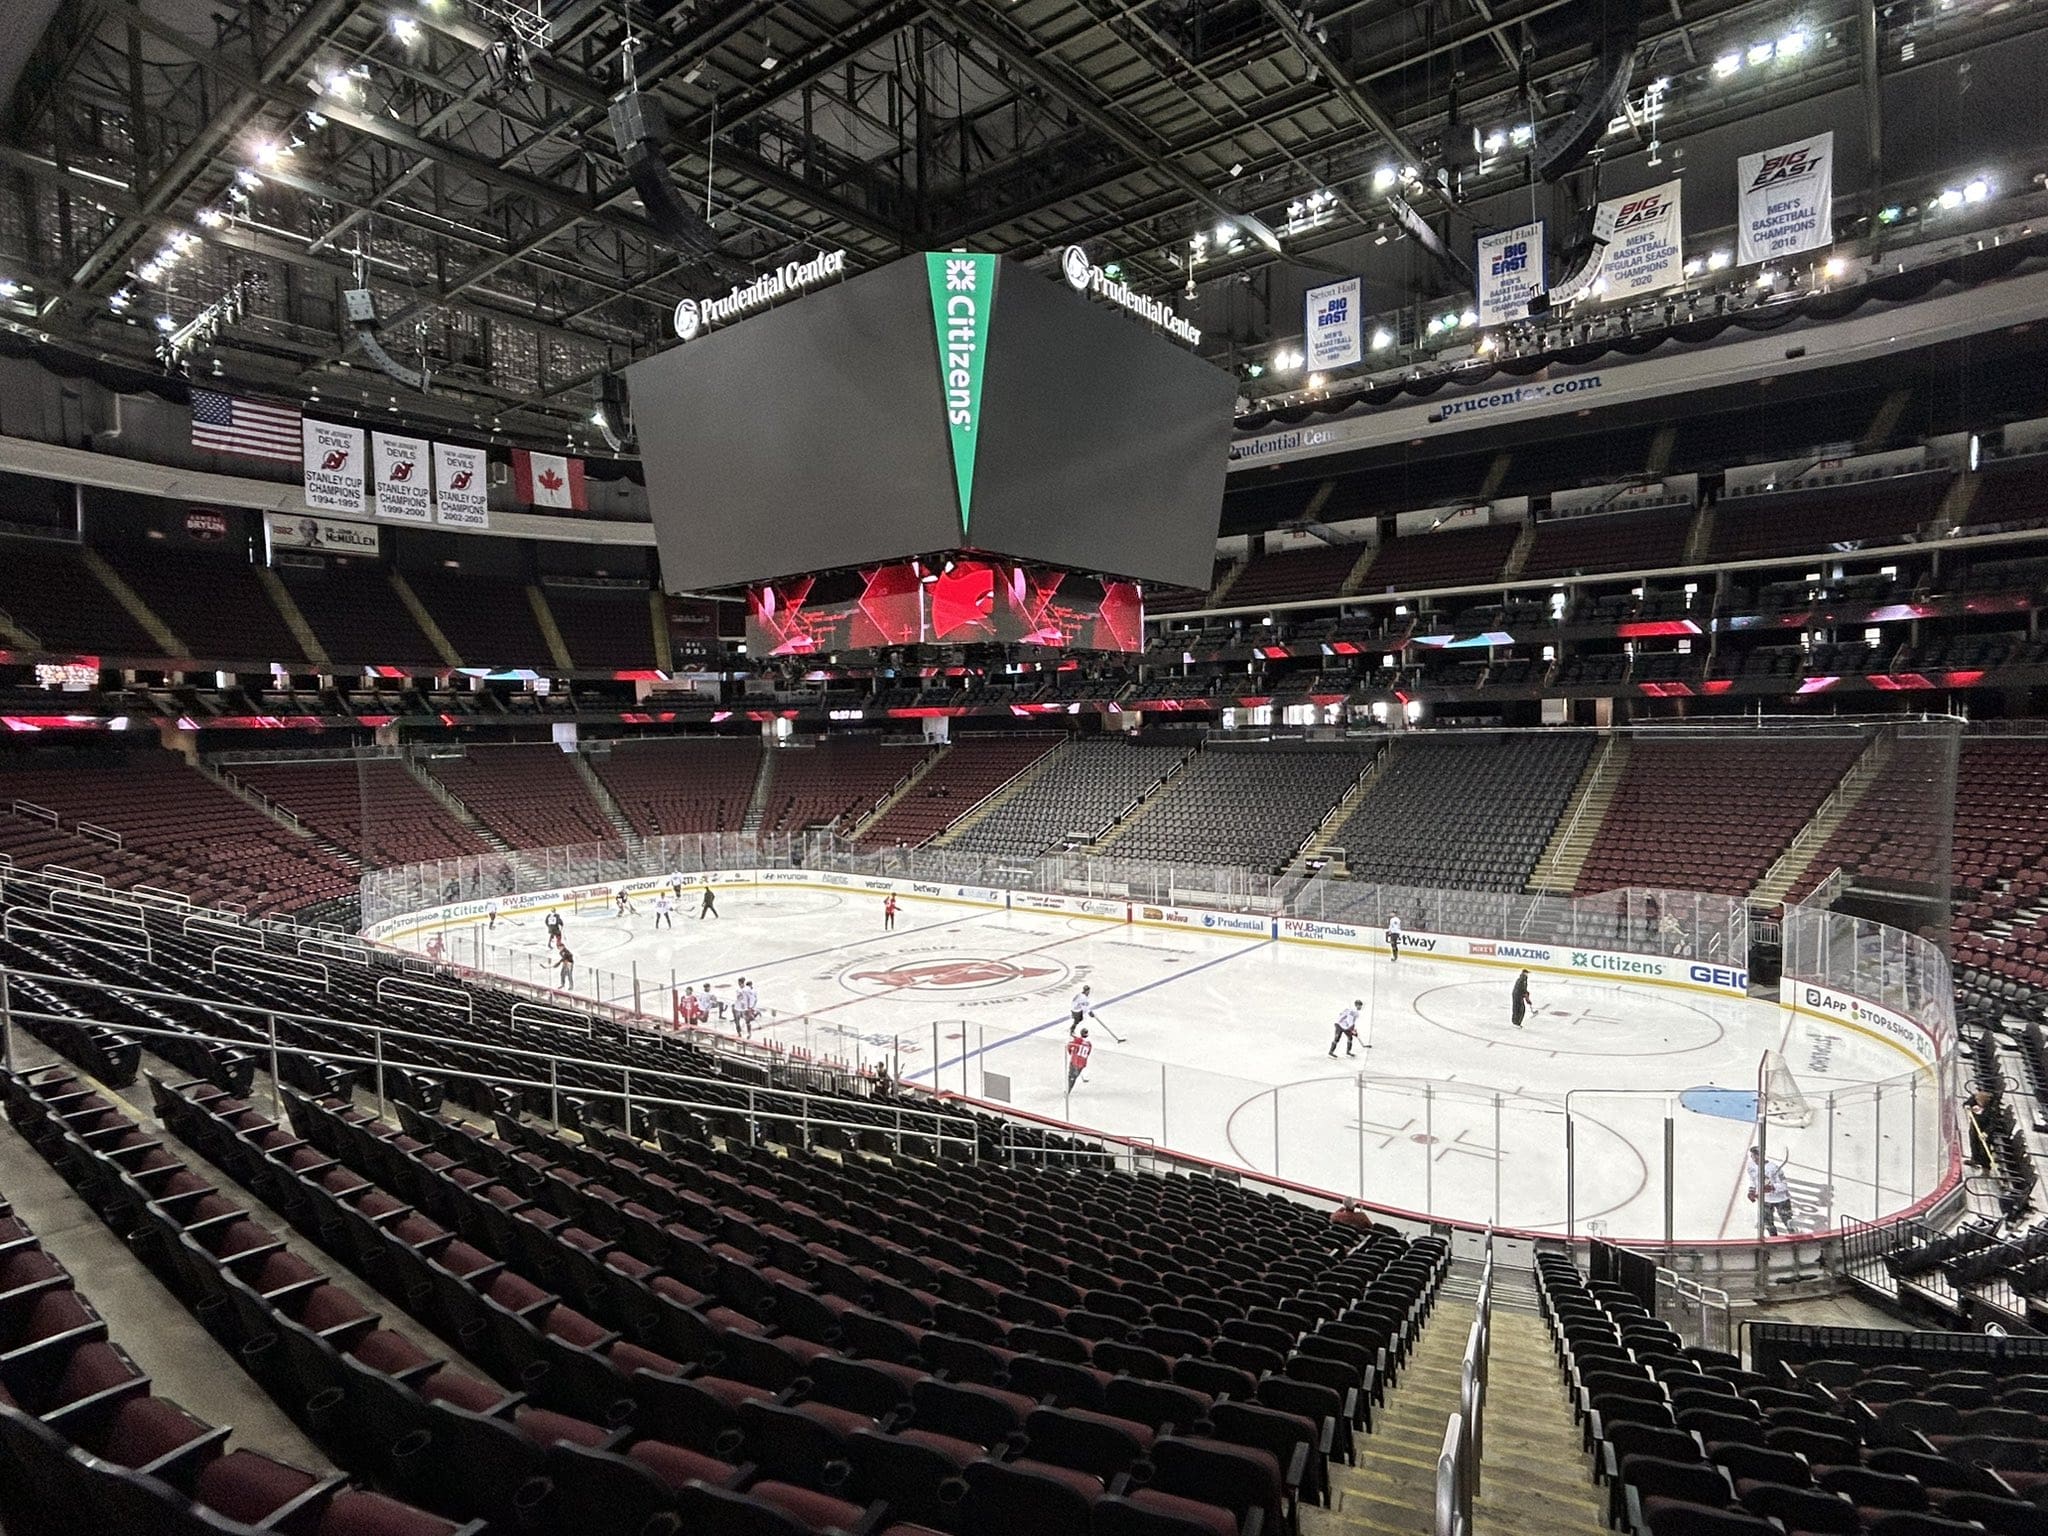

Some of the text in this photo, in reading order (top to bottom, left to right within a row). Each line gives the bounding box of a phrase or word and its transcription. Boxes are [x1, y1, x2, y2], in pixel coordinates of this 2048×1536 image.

[1761, 147, 1810, 173] BIG
[1752, 156, 1823, 187] EAST
[1619, 194, 1662, 217] BIG
[1767, 198, 1800, 215] MEN'S
[1614, 201, 1673, 228] EAST
[1752, 207, 1816, 231] BASKETBALL
[1515, 226, 1539, 240] Hall
[1753, 219, 1816, 242] CHAMPIONS
[1626, 231, 1655, 247] MEN'S
[1771, 236, 1797, 250] 2016
[1504, 242, 1527, 258] BIG
[1613, 238, 1667, 260] BASKETBALL
[1492, 255, 1528, 275] EAST
[1605, 245, 1678, 272] REGULAR SEASON
[1614, 259, 1668, 280] CHAMPIONS
[700, 249, 847, 324] Prudential Center
[1091, 265, 1201, 346] Prudential Center
[1328, 297, 1347, 312] BIG
[1318, 310, 1347, 327] EAST
[948, 295, 976, 427] Citizens
[1440, 375, 1602, 419] prucenter.com
[319, 435, 350, 449] DEVILS
[387, 447, 416, 460] DEVILS
[447, 457, 474, 469] DEVILS
[306, 470, 362, 488] STANLEY CUP
[309, 482, 361, 499] CHAMPIONS
[377, 482, 429, 497] STANLEY CUP
[439, 490, 486, 505] STANLEY CUP
[312, 494, 359, 508] 1994-1995
[380, 493, 427, 508] CHAMPIONS
[441, 501, 485, 515] CHAMPIONS
[383, 504, 425, 517] 1999-2000
[444, 512, 484, 524] 2002-2003
[913, 883, 941, 896] betway
[453, 904, 489, 917] Citize
[1218, 917, 1264, 931] Prudential
[1294, 931, 1323, 940] HEALTH
[1497, 946, 1551, 960] AMAZING
[1591, 955, 1663, 975] Citizens
[1690, 965, 1748, 989] GEI
